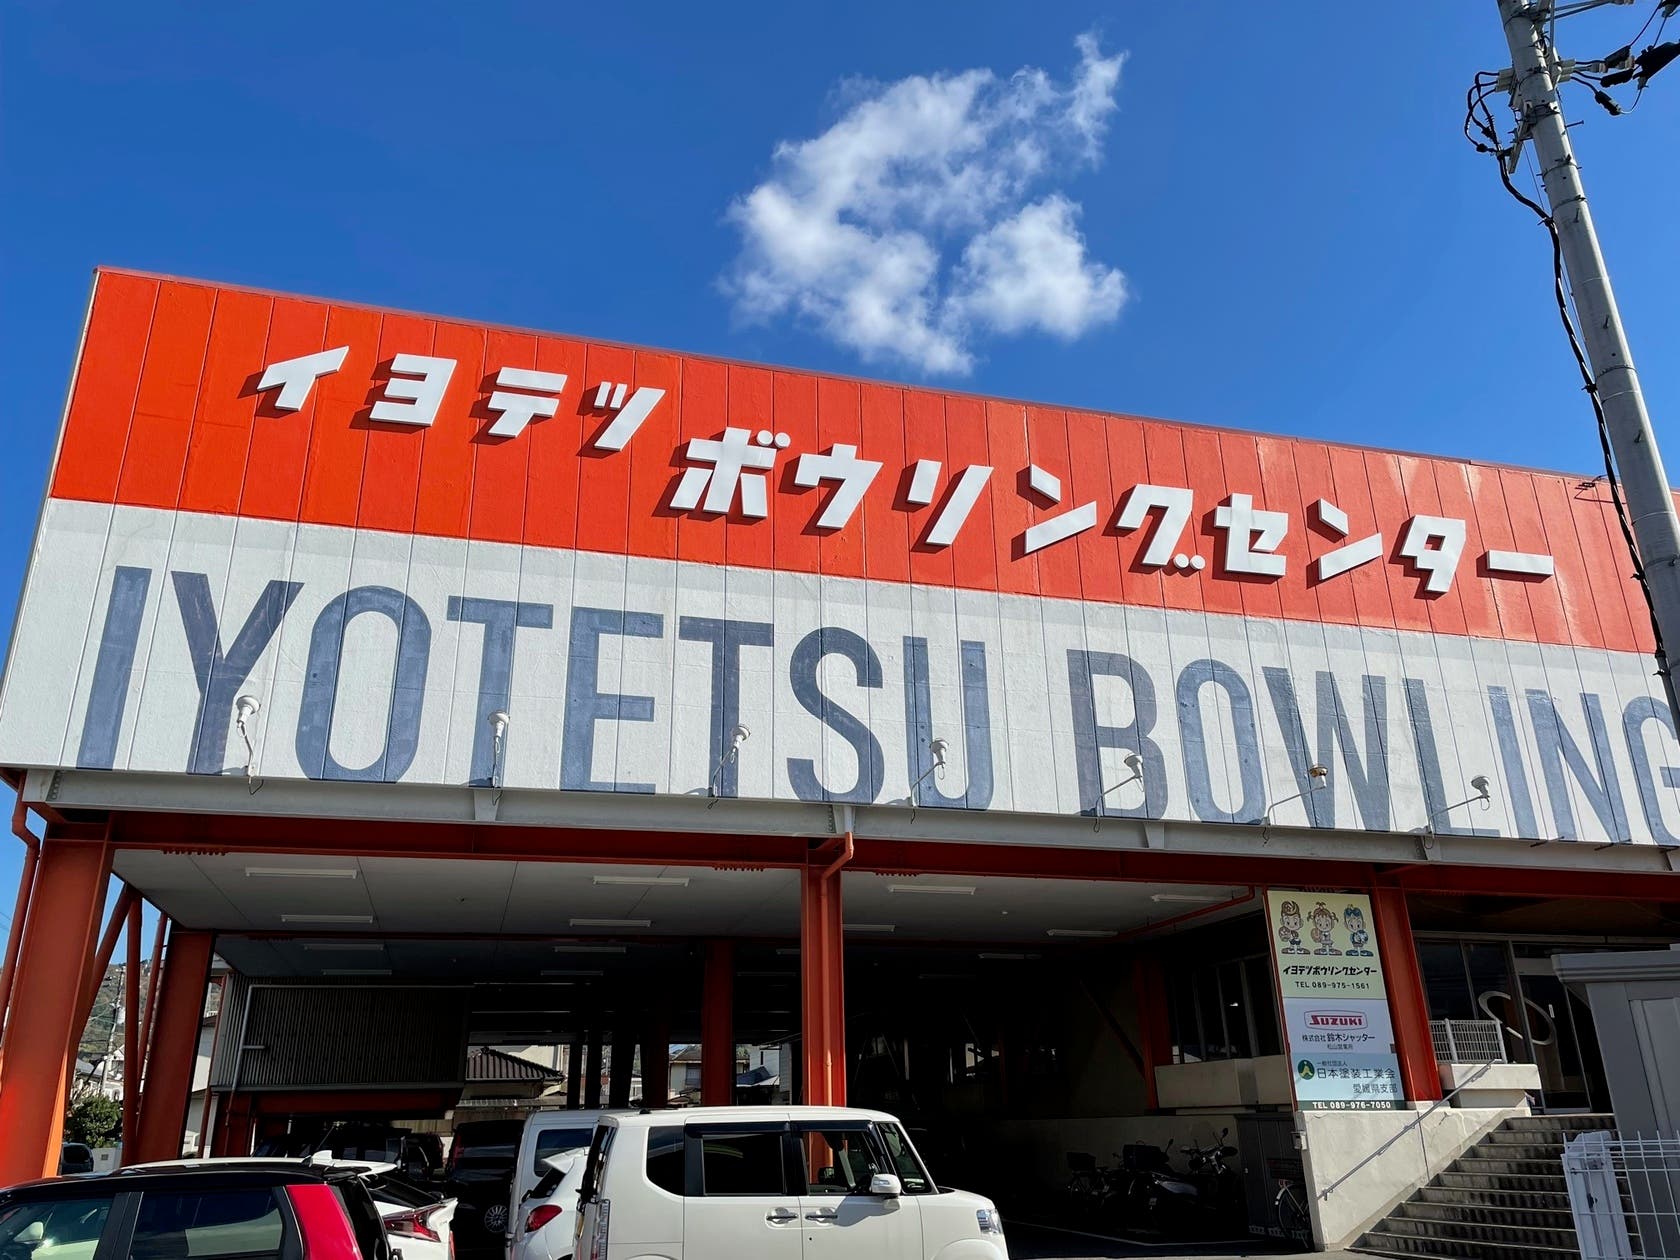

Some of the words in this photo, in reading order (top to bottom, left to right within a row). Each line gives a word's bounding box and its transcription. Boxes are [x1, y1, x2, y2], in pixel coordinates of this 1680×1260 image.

[76, 564, 995, 810] IYOTETSU
[1067, 648, 1680, 846] BOWLING
[1295, 981, 1310, 989] TEL
[1309, 1014, 1363, 1026] SUZUKI
[1316, 1067, 1396, 1079] 日本塗装工業会
[1312, 1101, 1328, 1109] TEL
[1329, 1101, 1391, 1109] 089-976-7050
